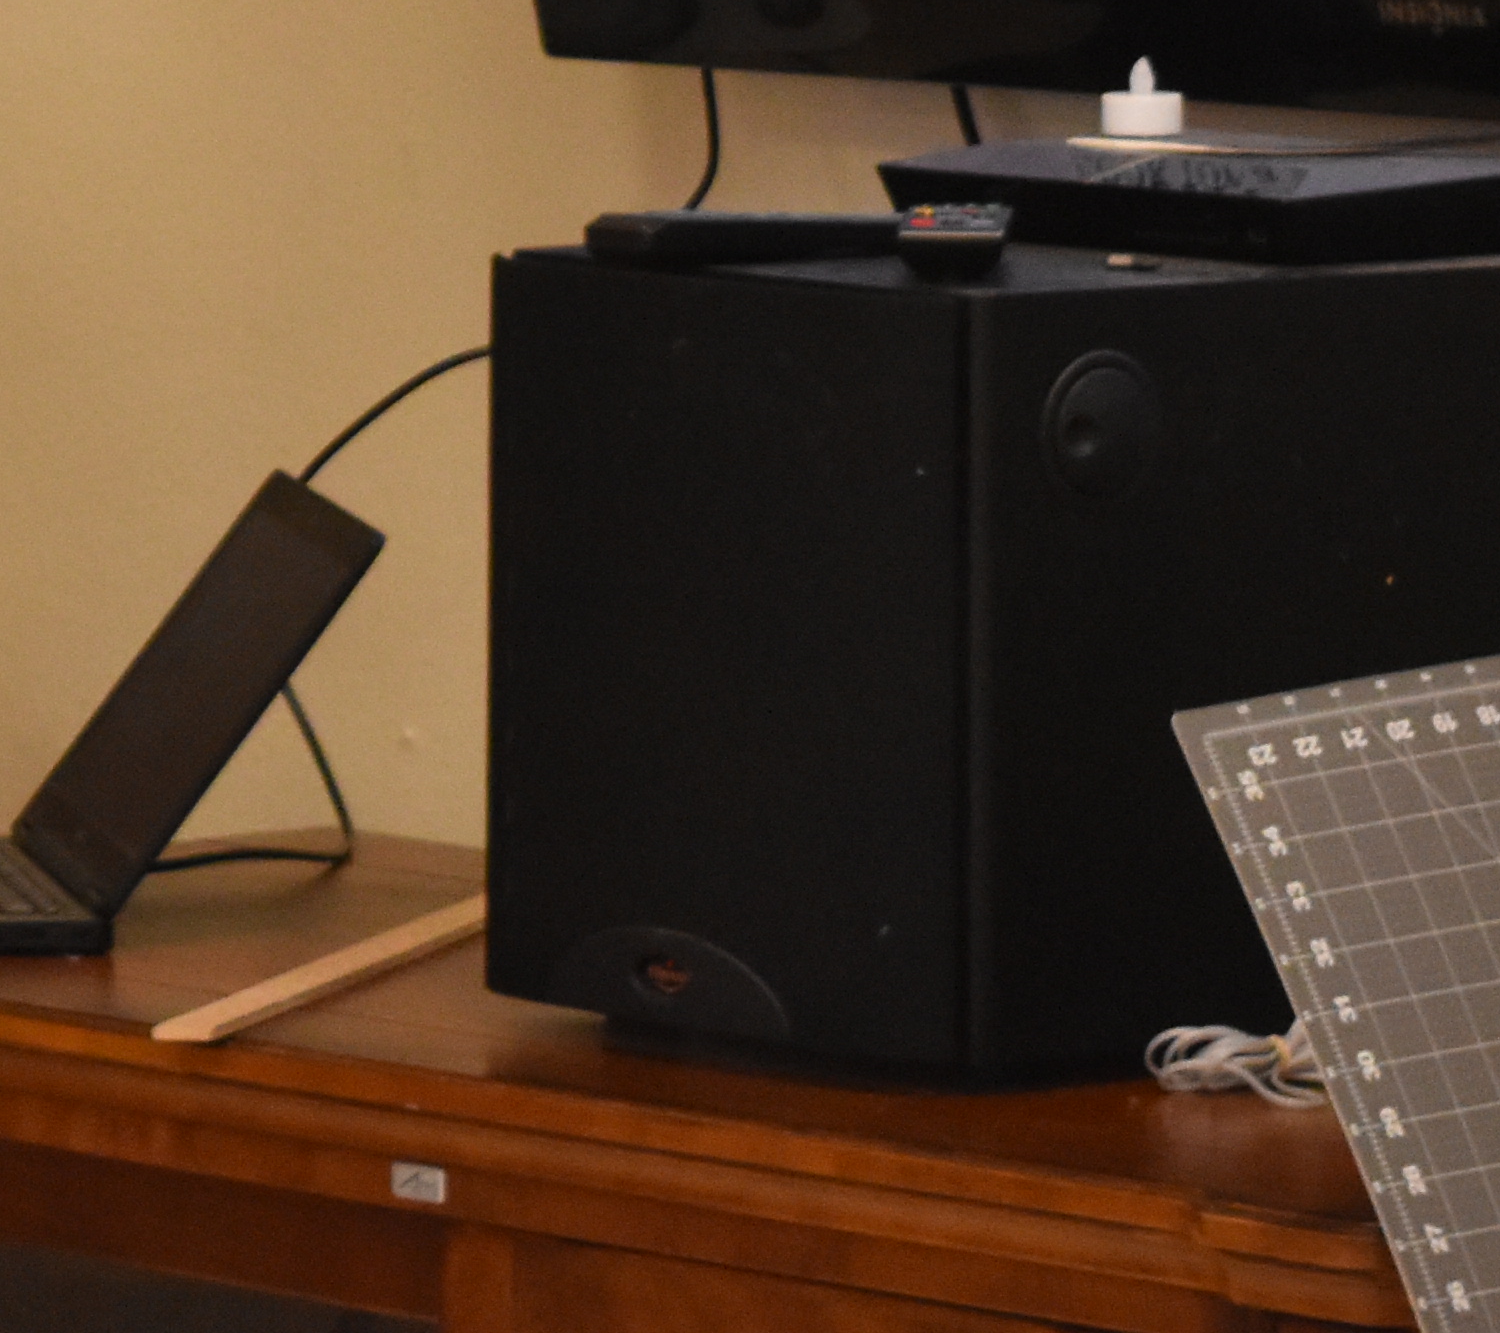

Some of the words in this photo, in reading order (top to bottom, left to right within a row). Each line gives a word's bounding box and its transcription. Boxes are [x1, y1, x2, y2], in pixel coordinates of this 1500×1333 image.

[1386, 719, 1415, 743] 20
[1432, 712, 1459, 734] 19
[1292, 735, 1322, 759] 22
[1341, 726, 1368, 750] 21
[1248, 743, 1278, 767] 23
